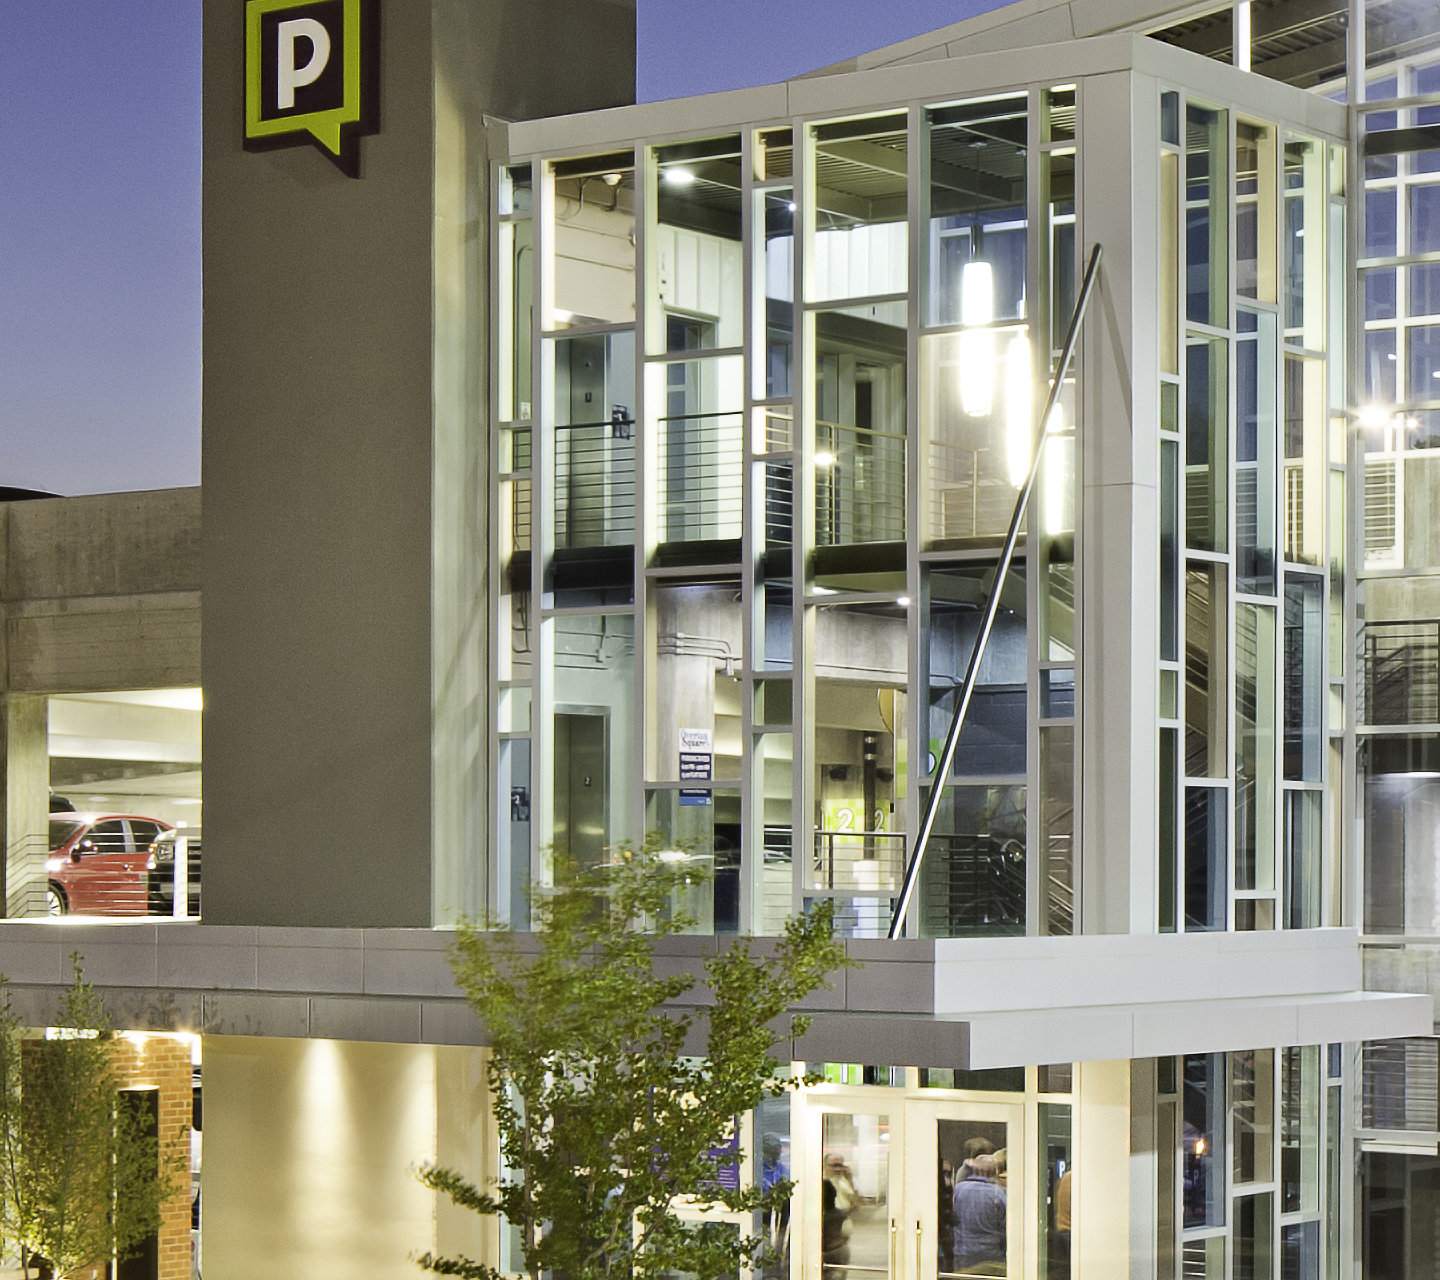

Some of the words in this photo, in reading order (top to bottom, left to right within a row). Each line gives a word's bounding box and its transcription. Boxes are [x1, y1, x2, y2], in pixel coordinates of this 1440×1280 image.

[277, 17, 331, 110] P
[836, 808, 855, 833] 2
[874, 808, 885, 833] 2
